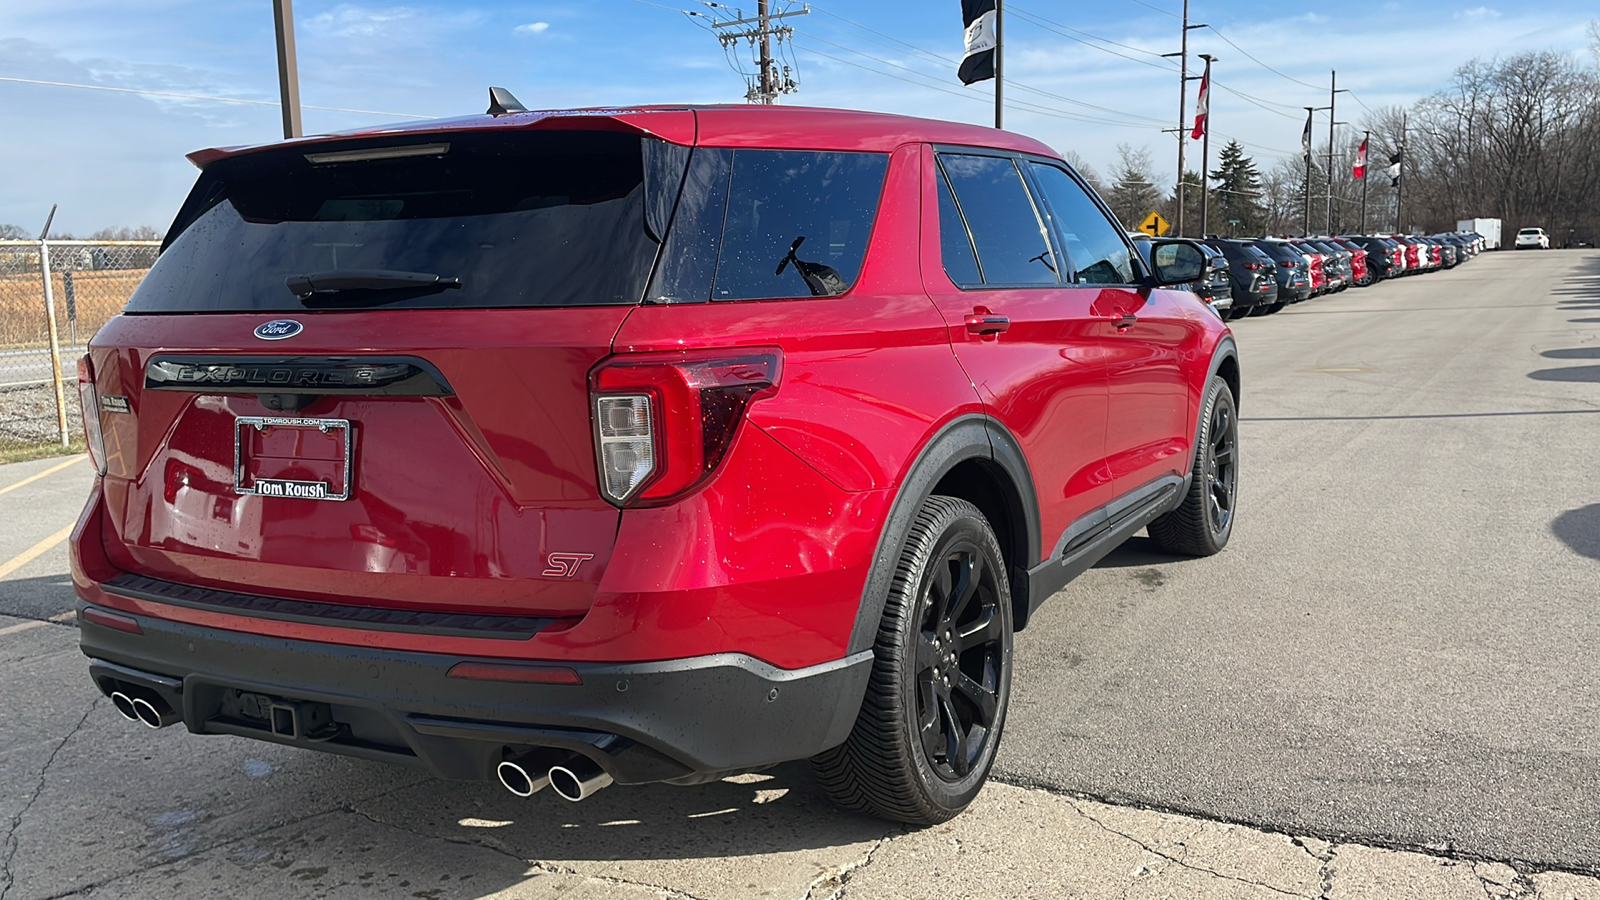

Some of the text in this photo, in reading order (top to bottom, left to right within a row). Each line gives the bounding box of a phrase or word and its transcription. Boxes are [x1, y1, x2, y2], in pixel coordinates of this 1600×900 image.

[262, 322, 291, 334] Ford
[177, 366, 377, 384] EXPLORER
[256, 481, 325, 498] Tom Roush
[542, 552, 594, 577] ST
